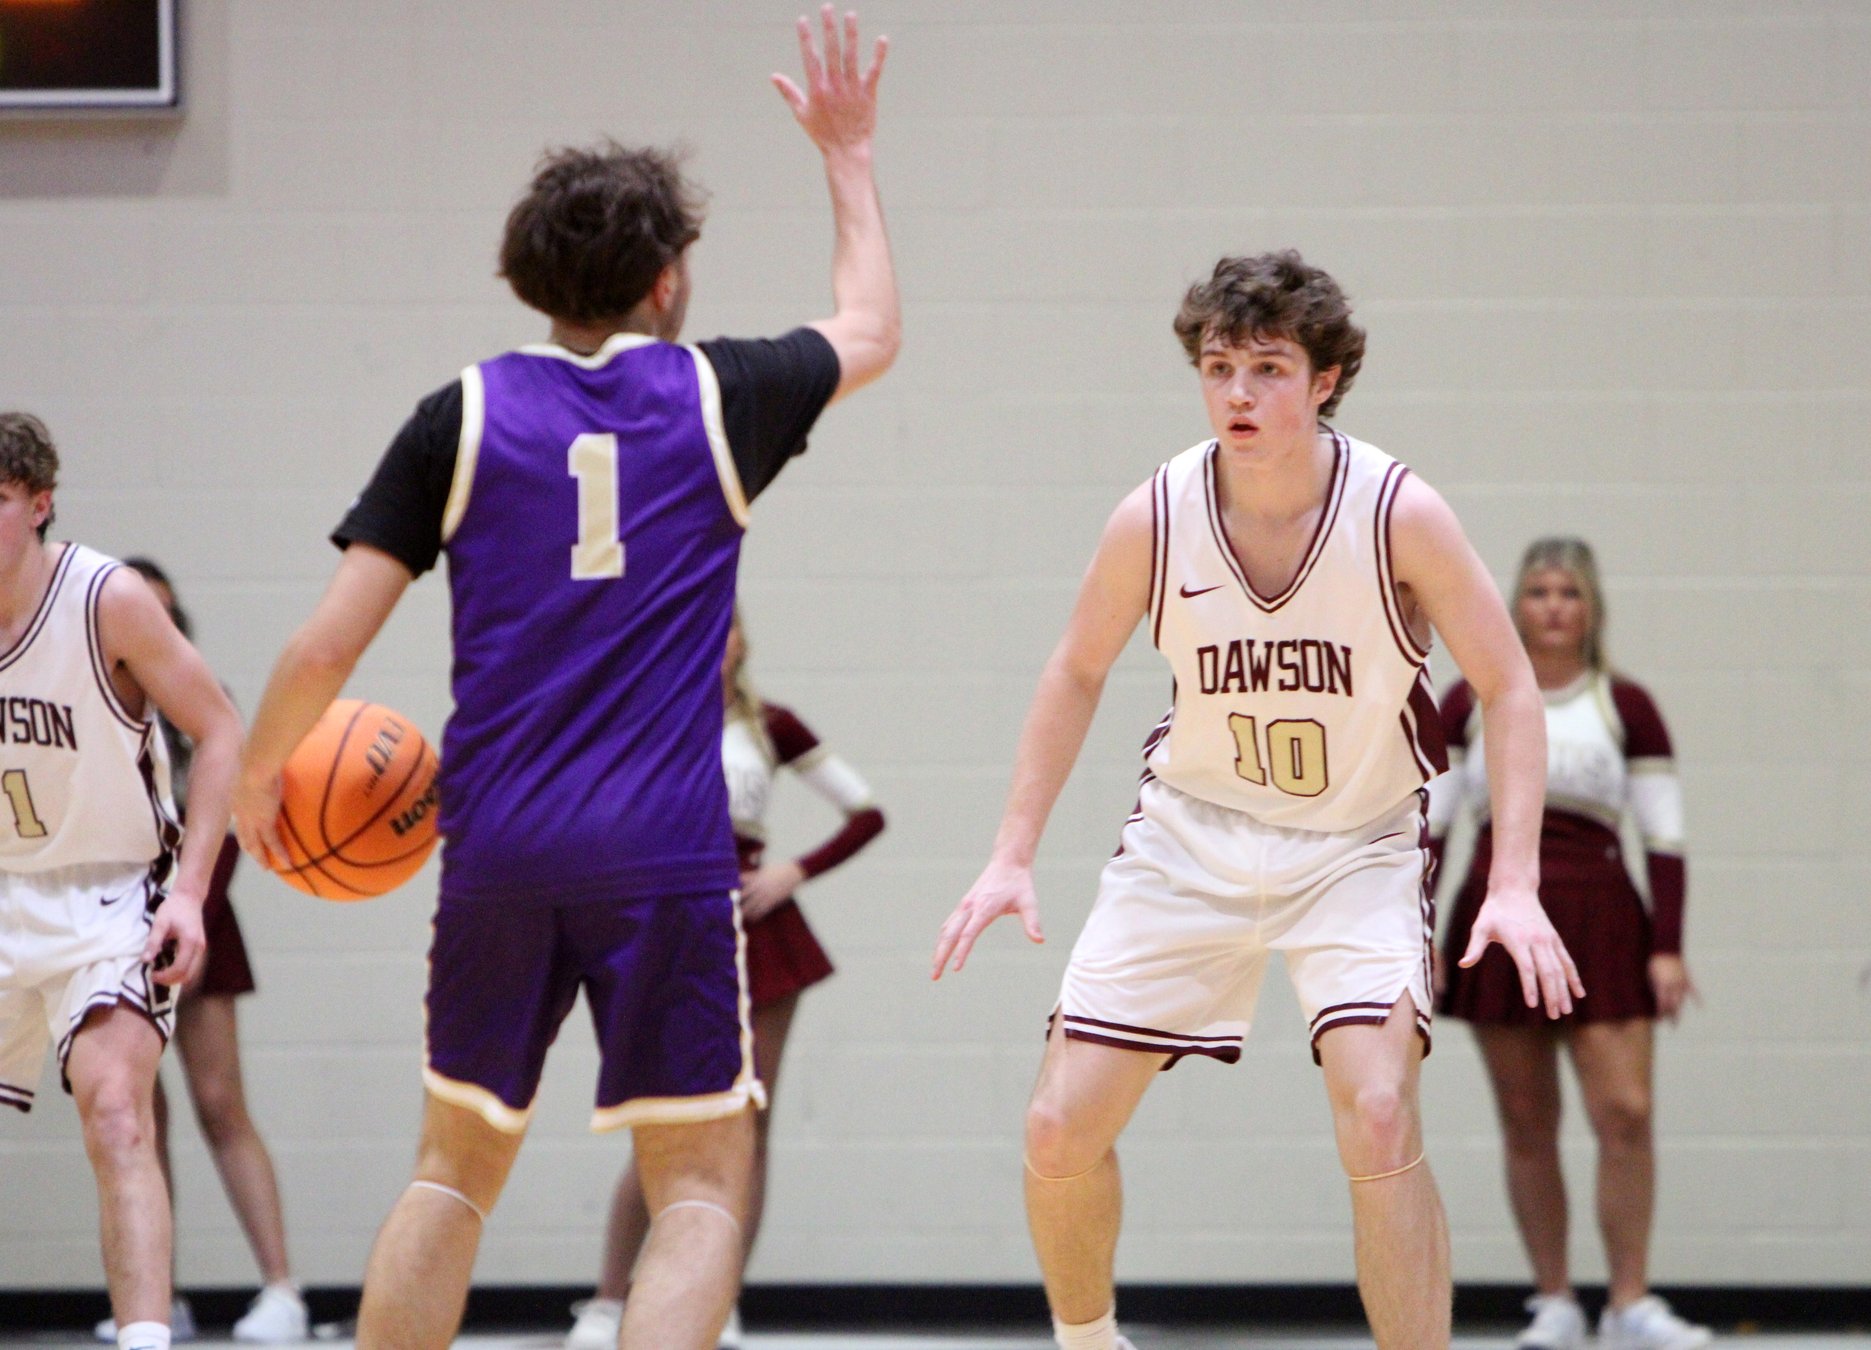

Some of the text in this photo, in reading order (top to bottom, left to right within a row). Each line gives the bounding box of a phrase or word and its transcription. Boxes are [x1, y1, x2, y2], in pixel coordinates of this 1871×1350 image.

[567, 432, 626, 580] 1
[1197, 638, 1353, 697] DAWSON
[1228, 711, 1329, 797] 10
